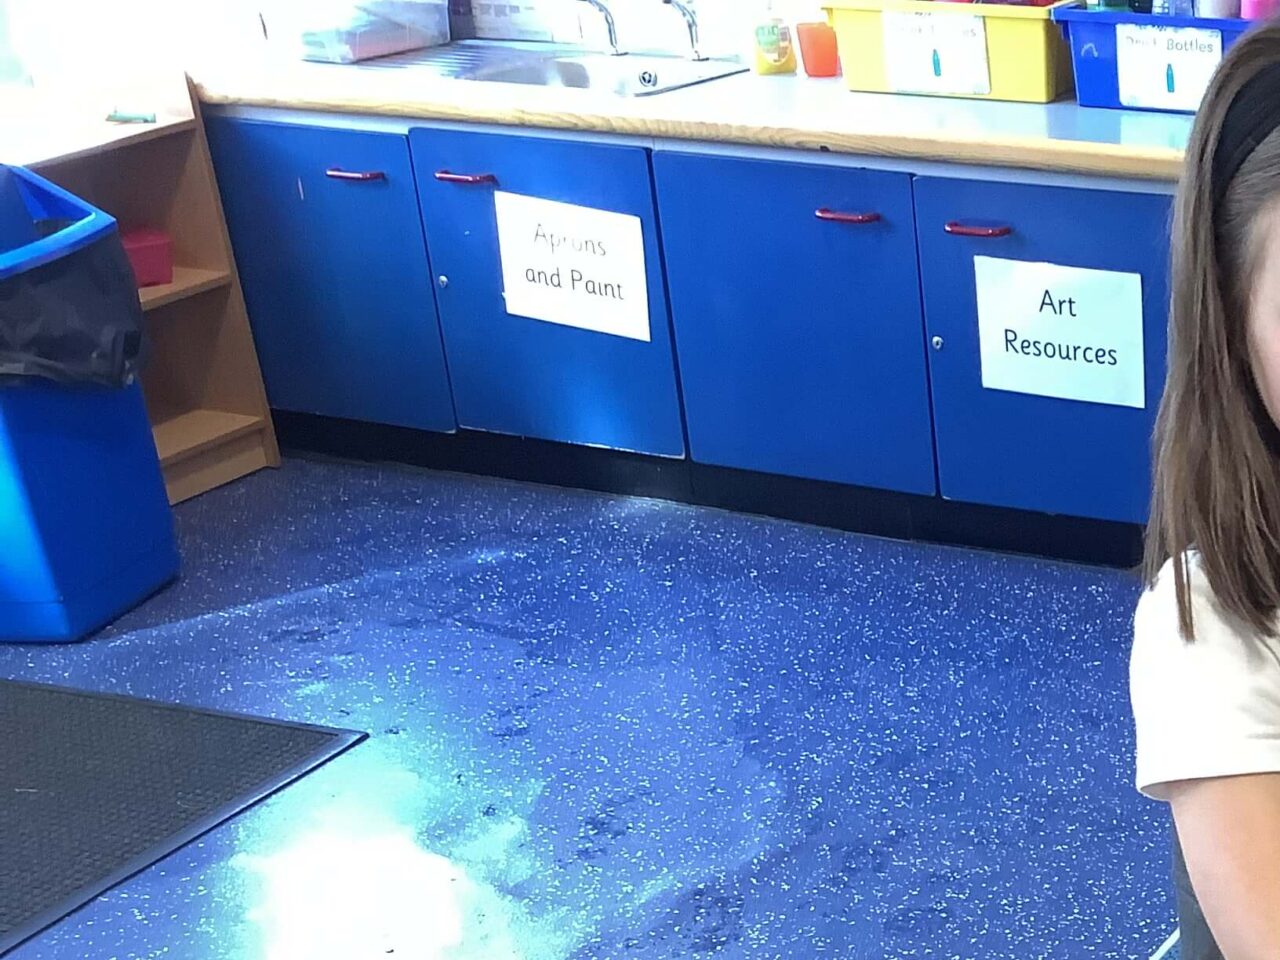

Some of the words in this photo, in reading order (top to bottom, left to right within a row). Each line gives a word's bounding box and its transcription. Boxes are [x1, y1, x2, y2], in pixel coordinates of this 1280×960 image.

[1166, 37, 1214, 53] Bottles
[534, 223, 606, 256] Apons
[525, 266, 562, 288] and
[571, 269, 624, 300] Paint
[1039, 289, 1077, 317] Art
[1004, 328, 1118, 366] Resources
